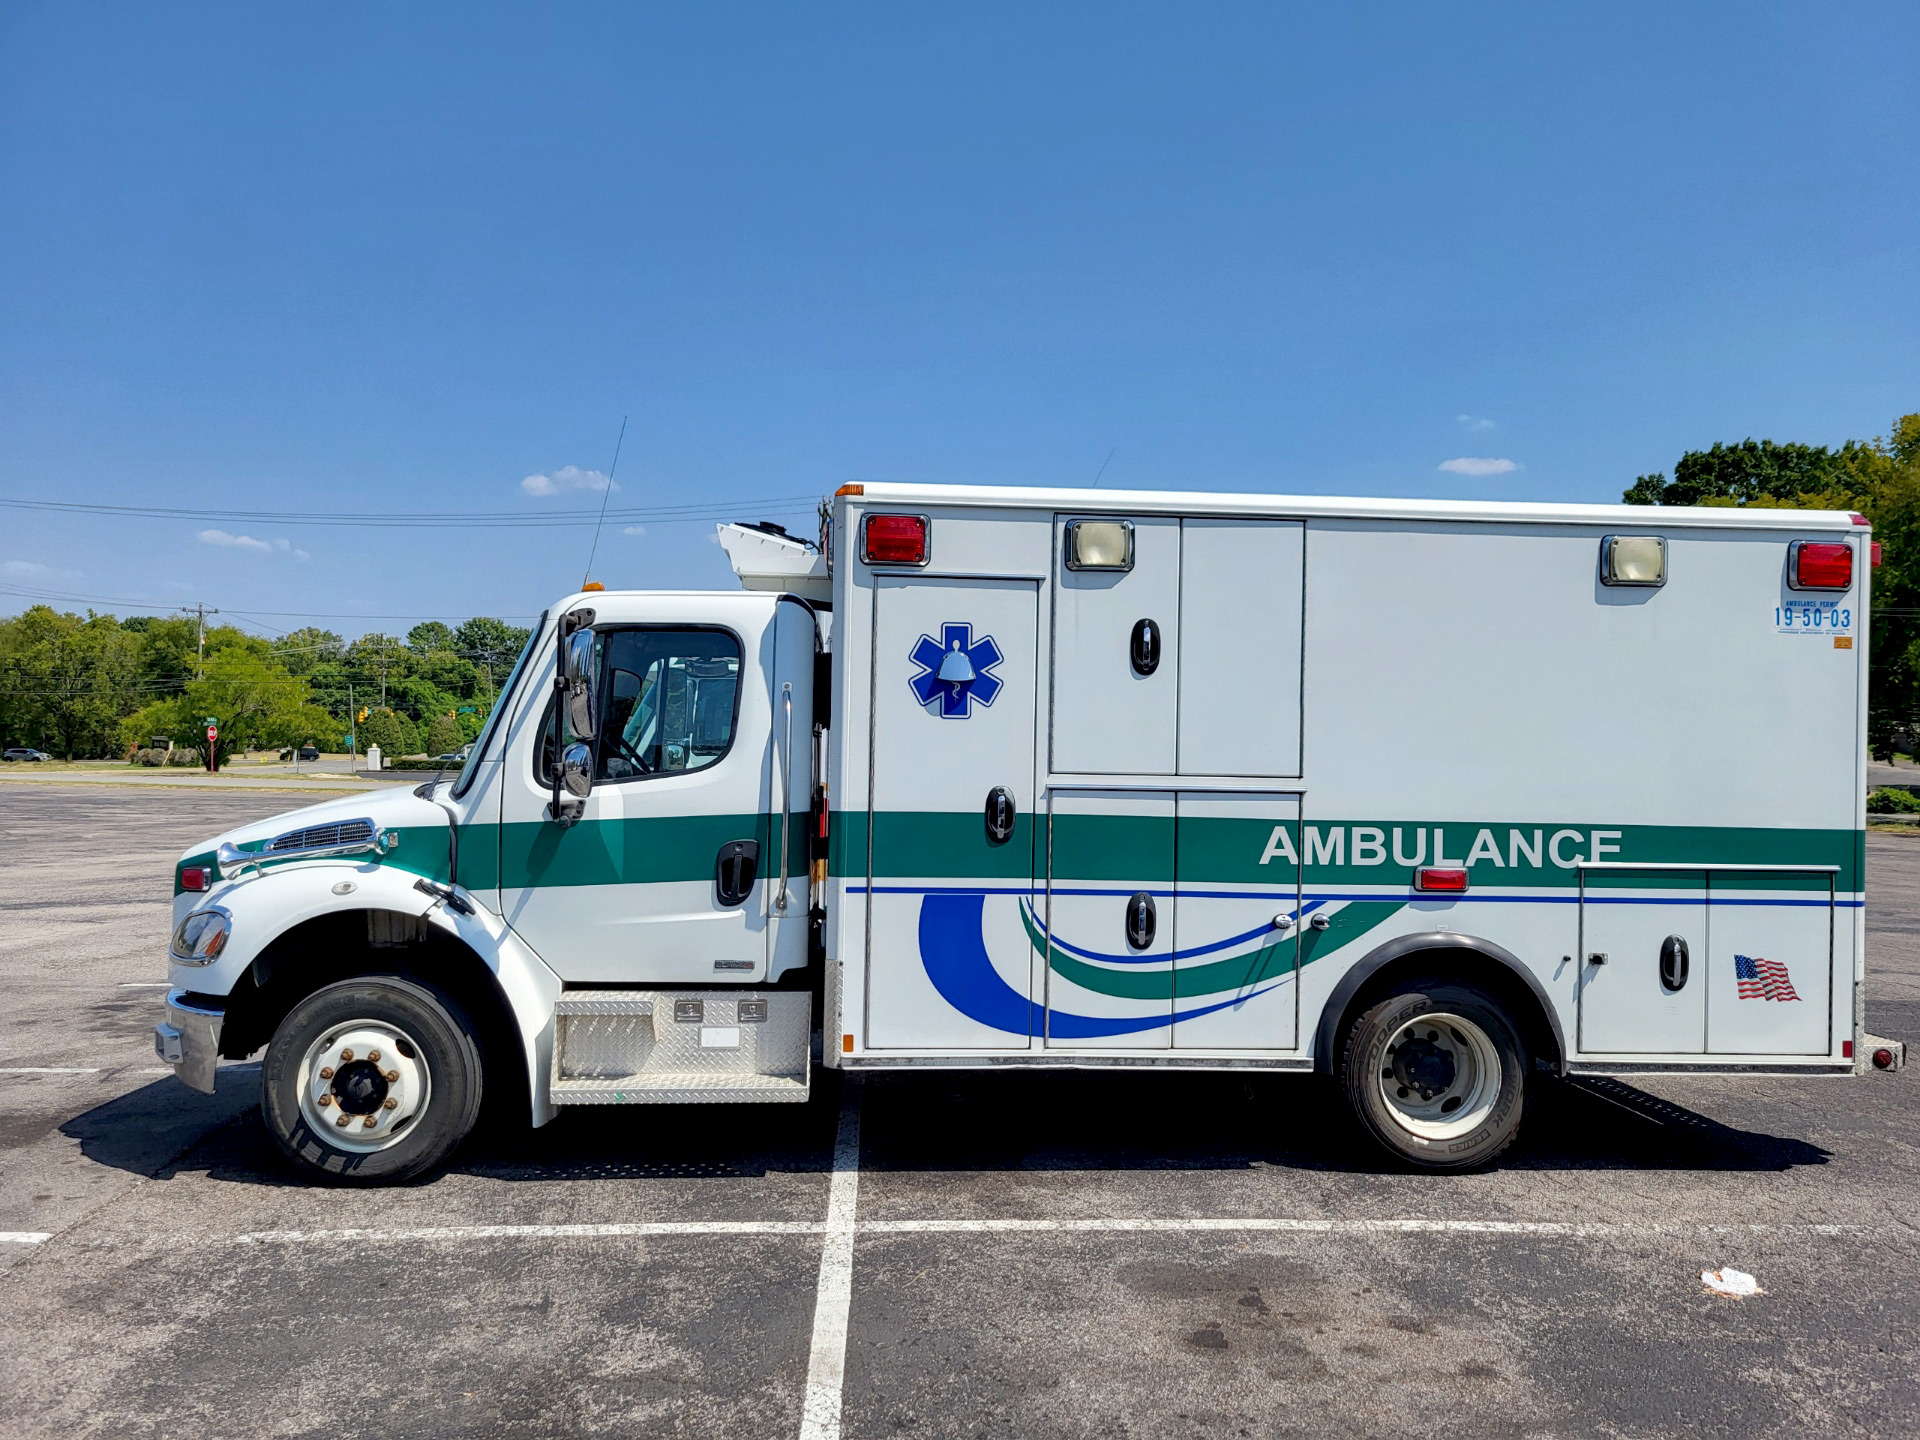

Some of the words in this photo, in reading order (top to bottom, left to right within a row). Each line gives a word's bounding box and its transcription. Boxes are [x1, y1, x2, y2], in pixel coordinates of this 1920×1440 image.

[1785, 600, 1817, 608] AMBULANCE
[1775, 607, 1850, 627] 19-50-03
[1258, 826, 1623, 868] AMBULANCE
[1367, 1001, 1427, 1076] COOPER
[1450, 1130, 1490, 1152] SERIES
